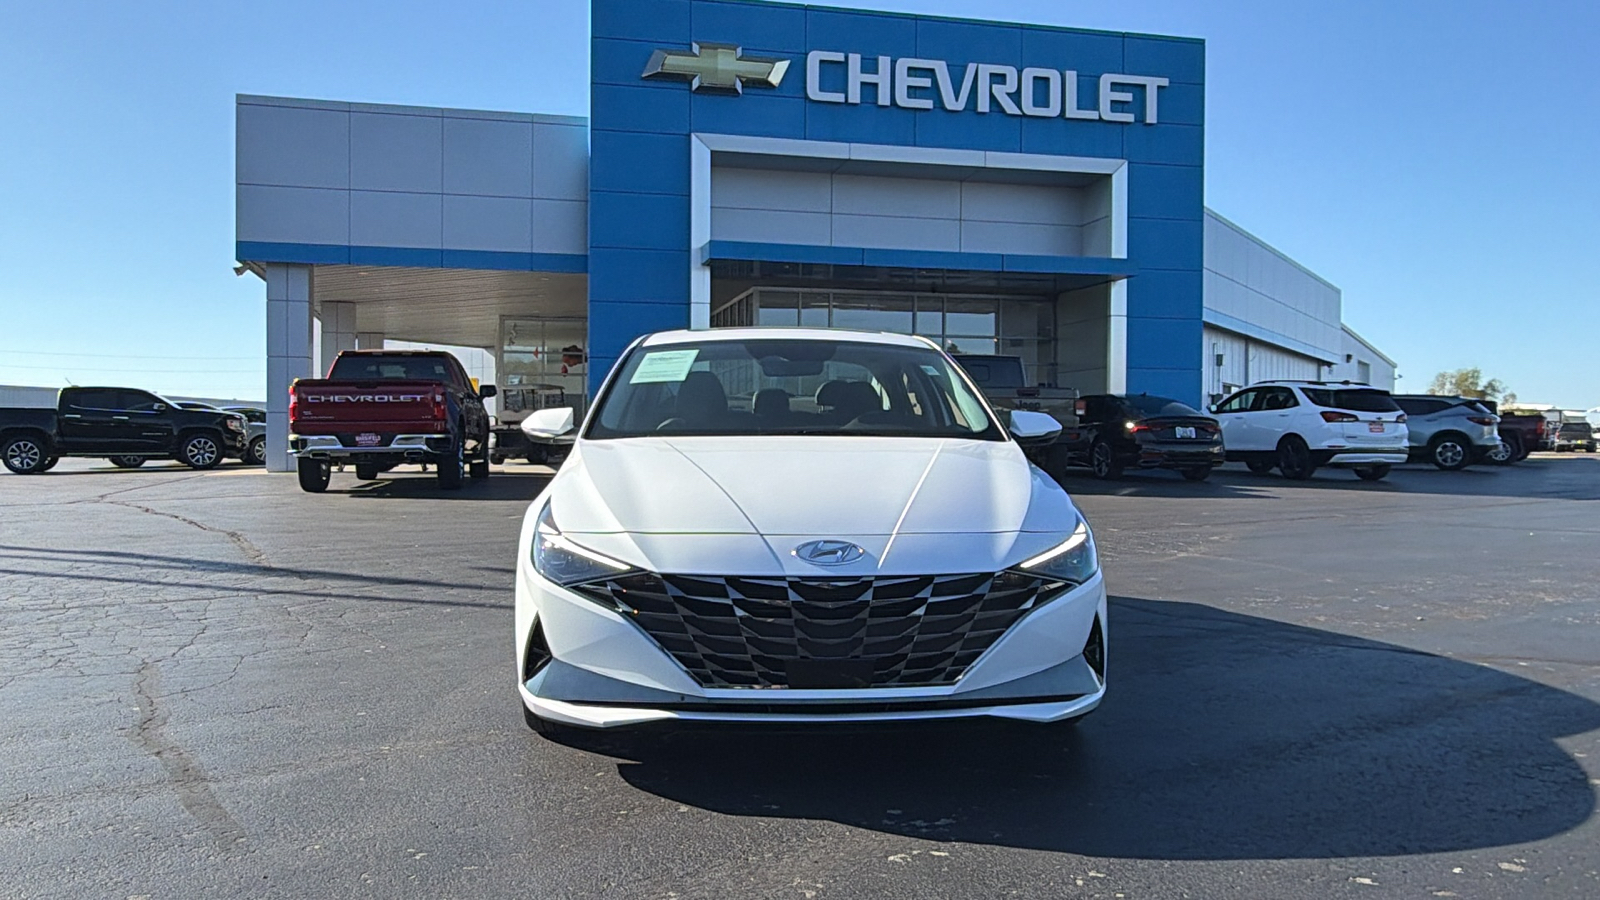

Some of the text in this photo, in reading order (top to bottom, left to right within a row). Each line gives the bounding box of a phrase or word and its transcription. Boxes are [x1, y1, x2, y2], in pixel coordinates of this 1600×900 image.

[806, 50, 1169, 124] CHEVROLET
[307, 394, 425, 403] CHEVROLET
[1015, 400, 1041, 410] Jeep
